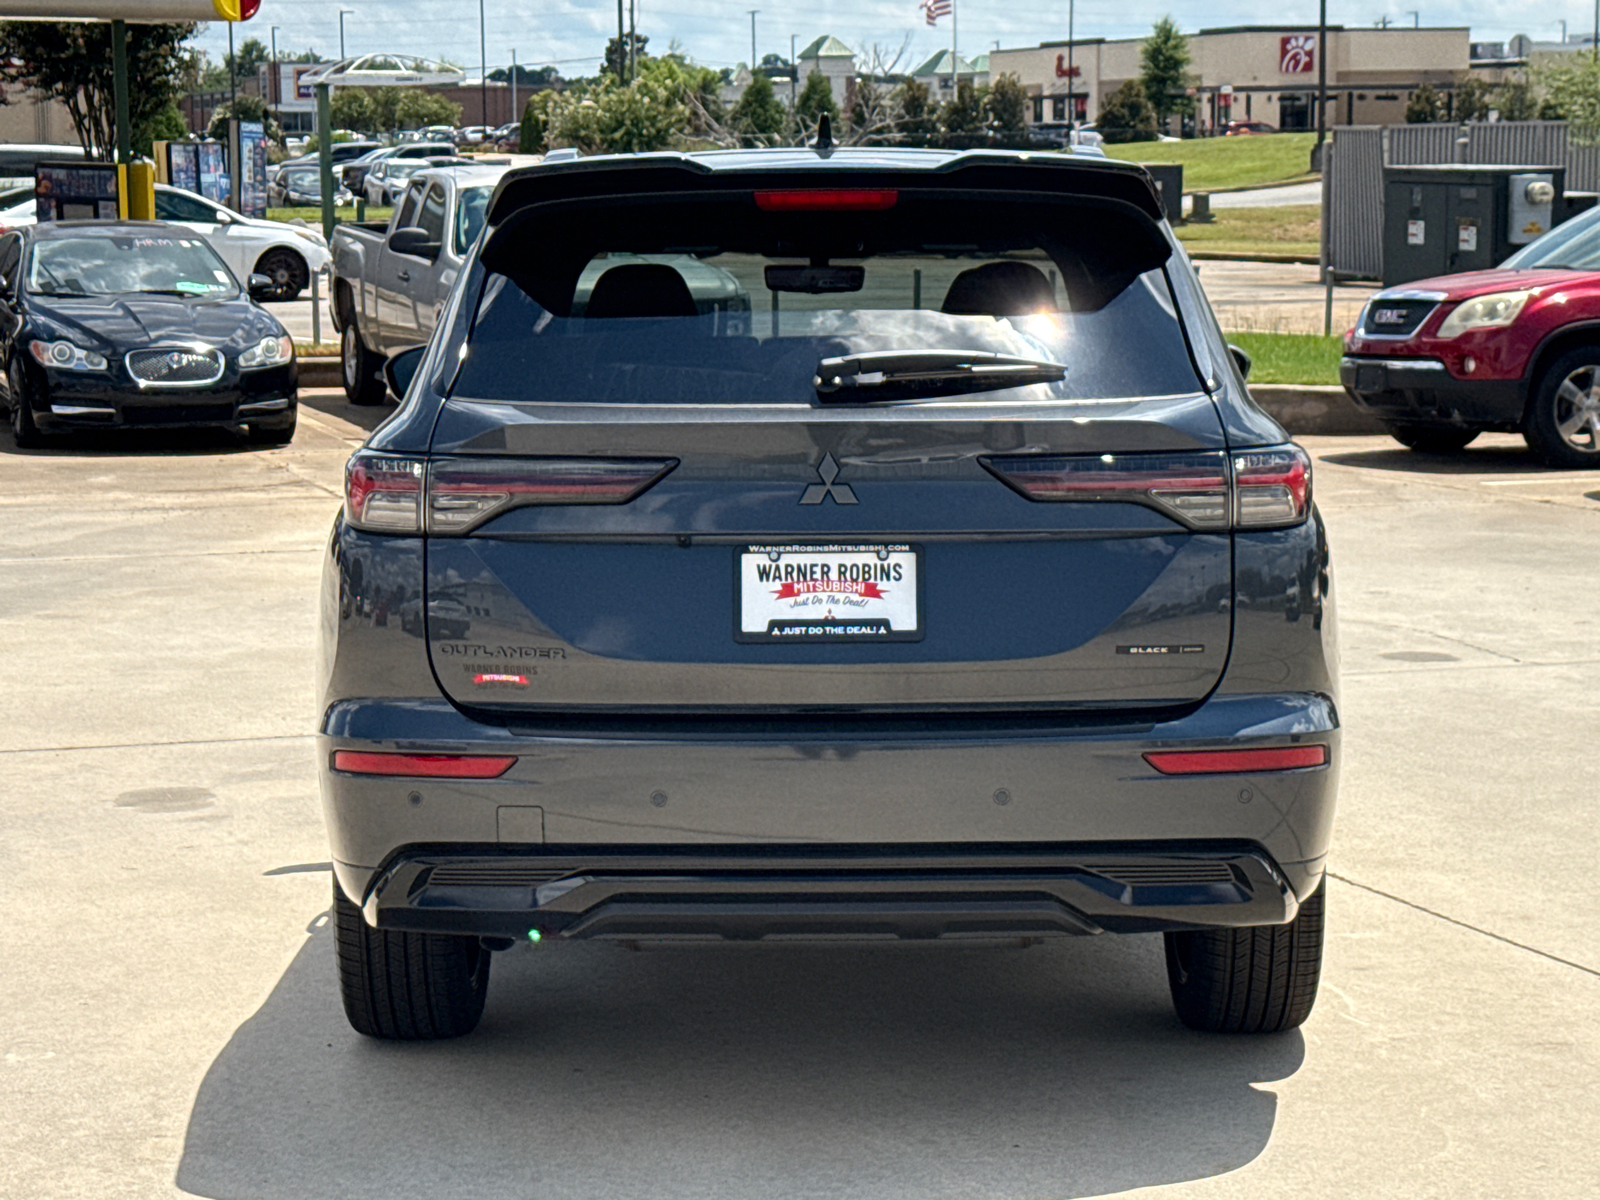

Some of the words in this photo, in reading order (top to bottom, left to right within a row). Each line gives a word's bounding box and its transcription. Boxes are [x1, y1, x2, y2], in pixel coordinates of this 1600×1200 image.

[1374, 309, 1407, 324] GMC
[757, 563, 831, 583] WARNER
[837, 562, 903, 582] ROBINS
[793, 580, 865, 594] MITSUBISHI
[790, 596, 809, 609] Just
[811, 595, 824, 606] Do
[825, 595, 841, 605] The
[782, 626, 807, 635] JUST
[808, 626, 824, 635] DO
[825, 626, 845, 635] THE
[846, 626, 876, 634] DEAL!
[441, 643, 567, 659] OUTLANDER
[1129, 646, 1168, 654] BLACK
[462, 663, 501, 675] WARNER
[504, 664, 538, 676] ROBINS
